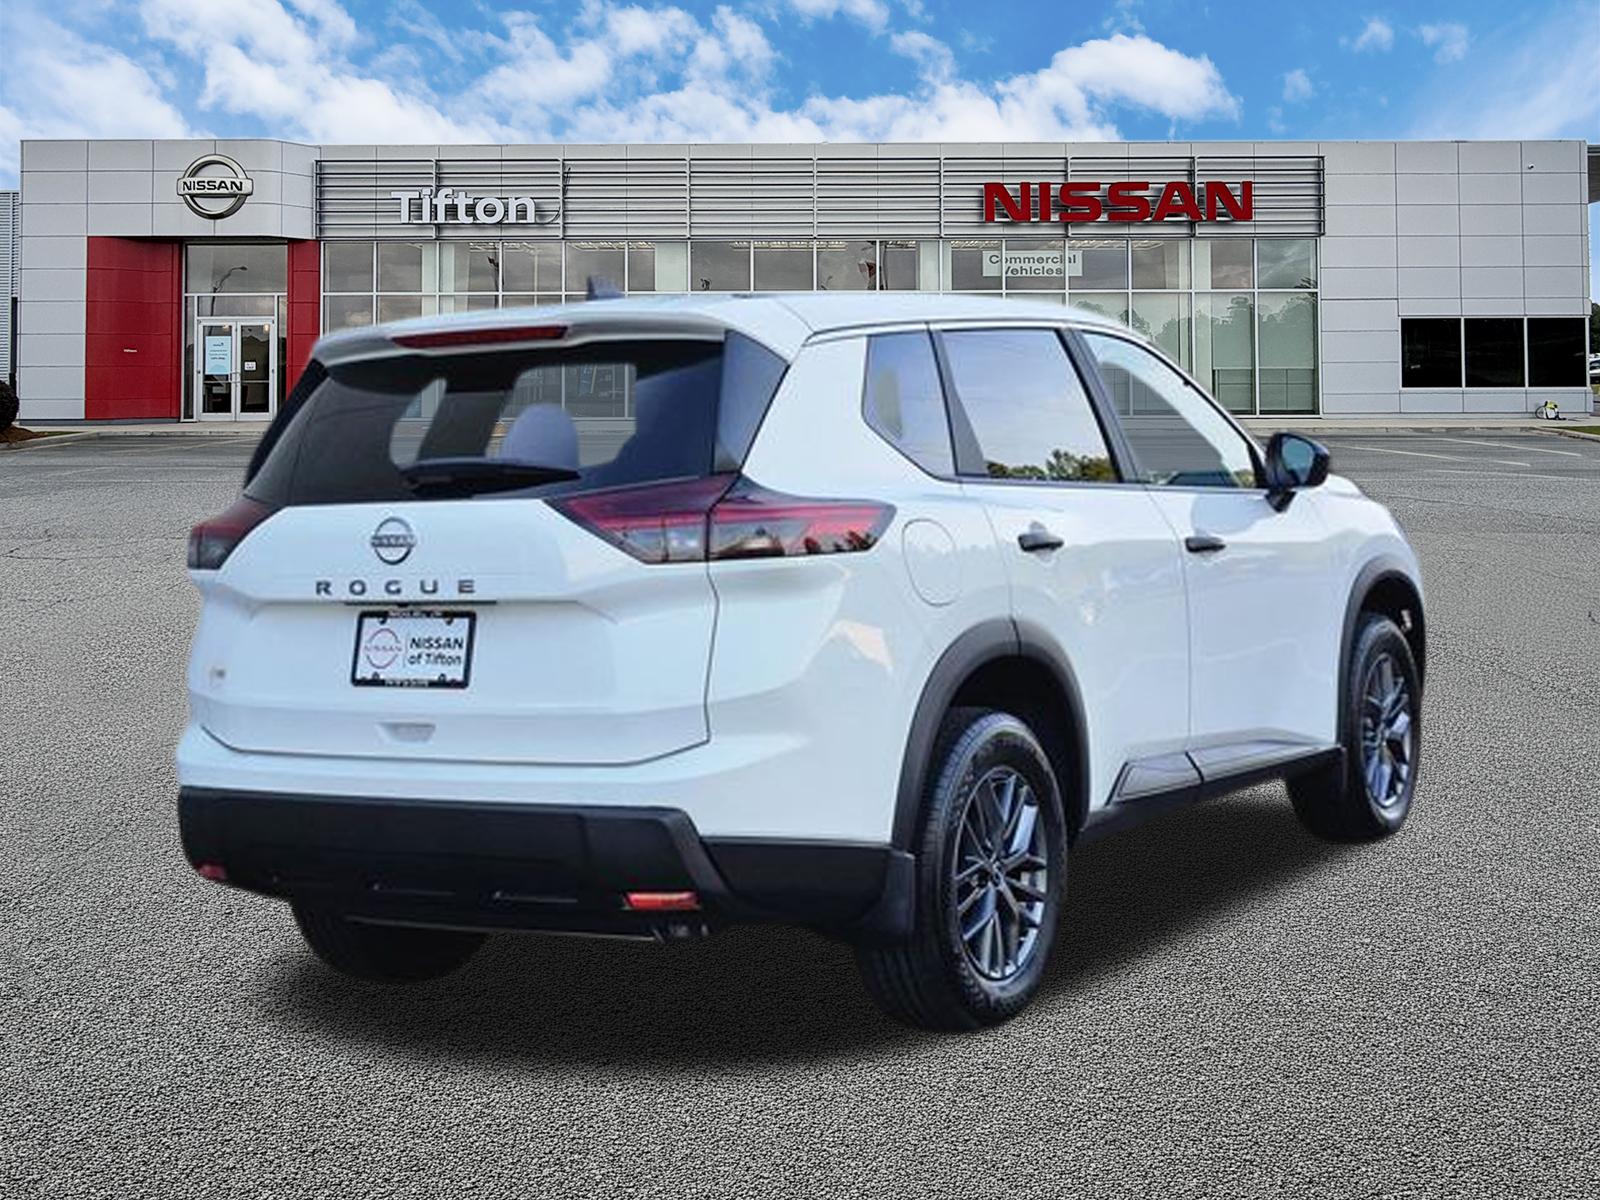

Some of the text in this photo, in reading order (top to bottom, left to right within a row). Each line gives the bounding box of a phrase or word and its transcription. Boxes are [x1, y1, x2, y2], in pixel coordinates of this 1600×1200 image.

[182, 180, 243, 191] NISSAN
[391, 188, 536, 224] Tifton
[983, 181, 1253, 222] NISSAN
[315, 579, 475, 596] ROGUE
[410, 637, 464, 650] NISSAN
[408, 653, 462, 665] of Tifton
